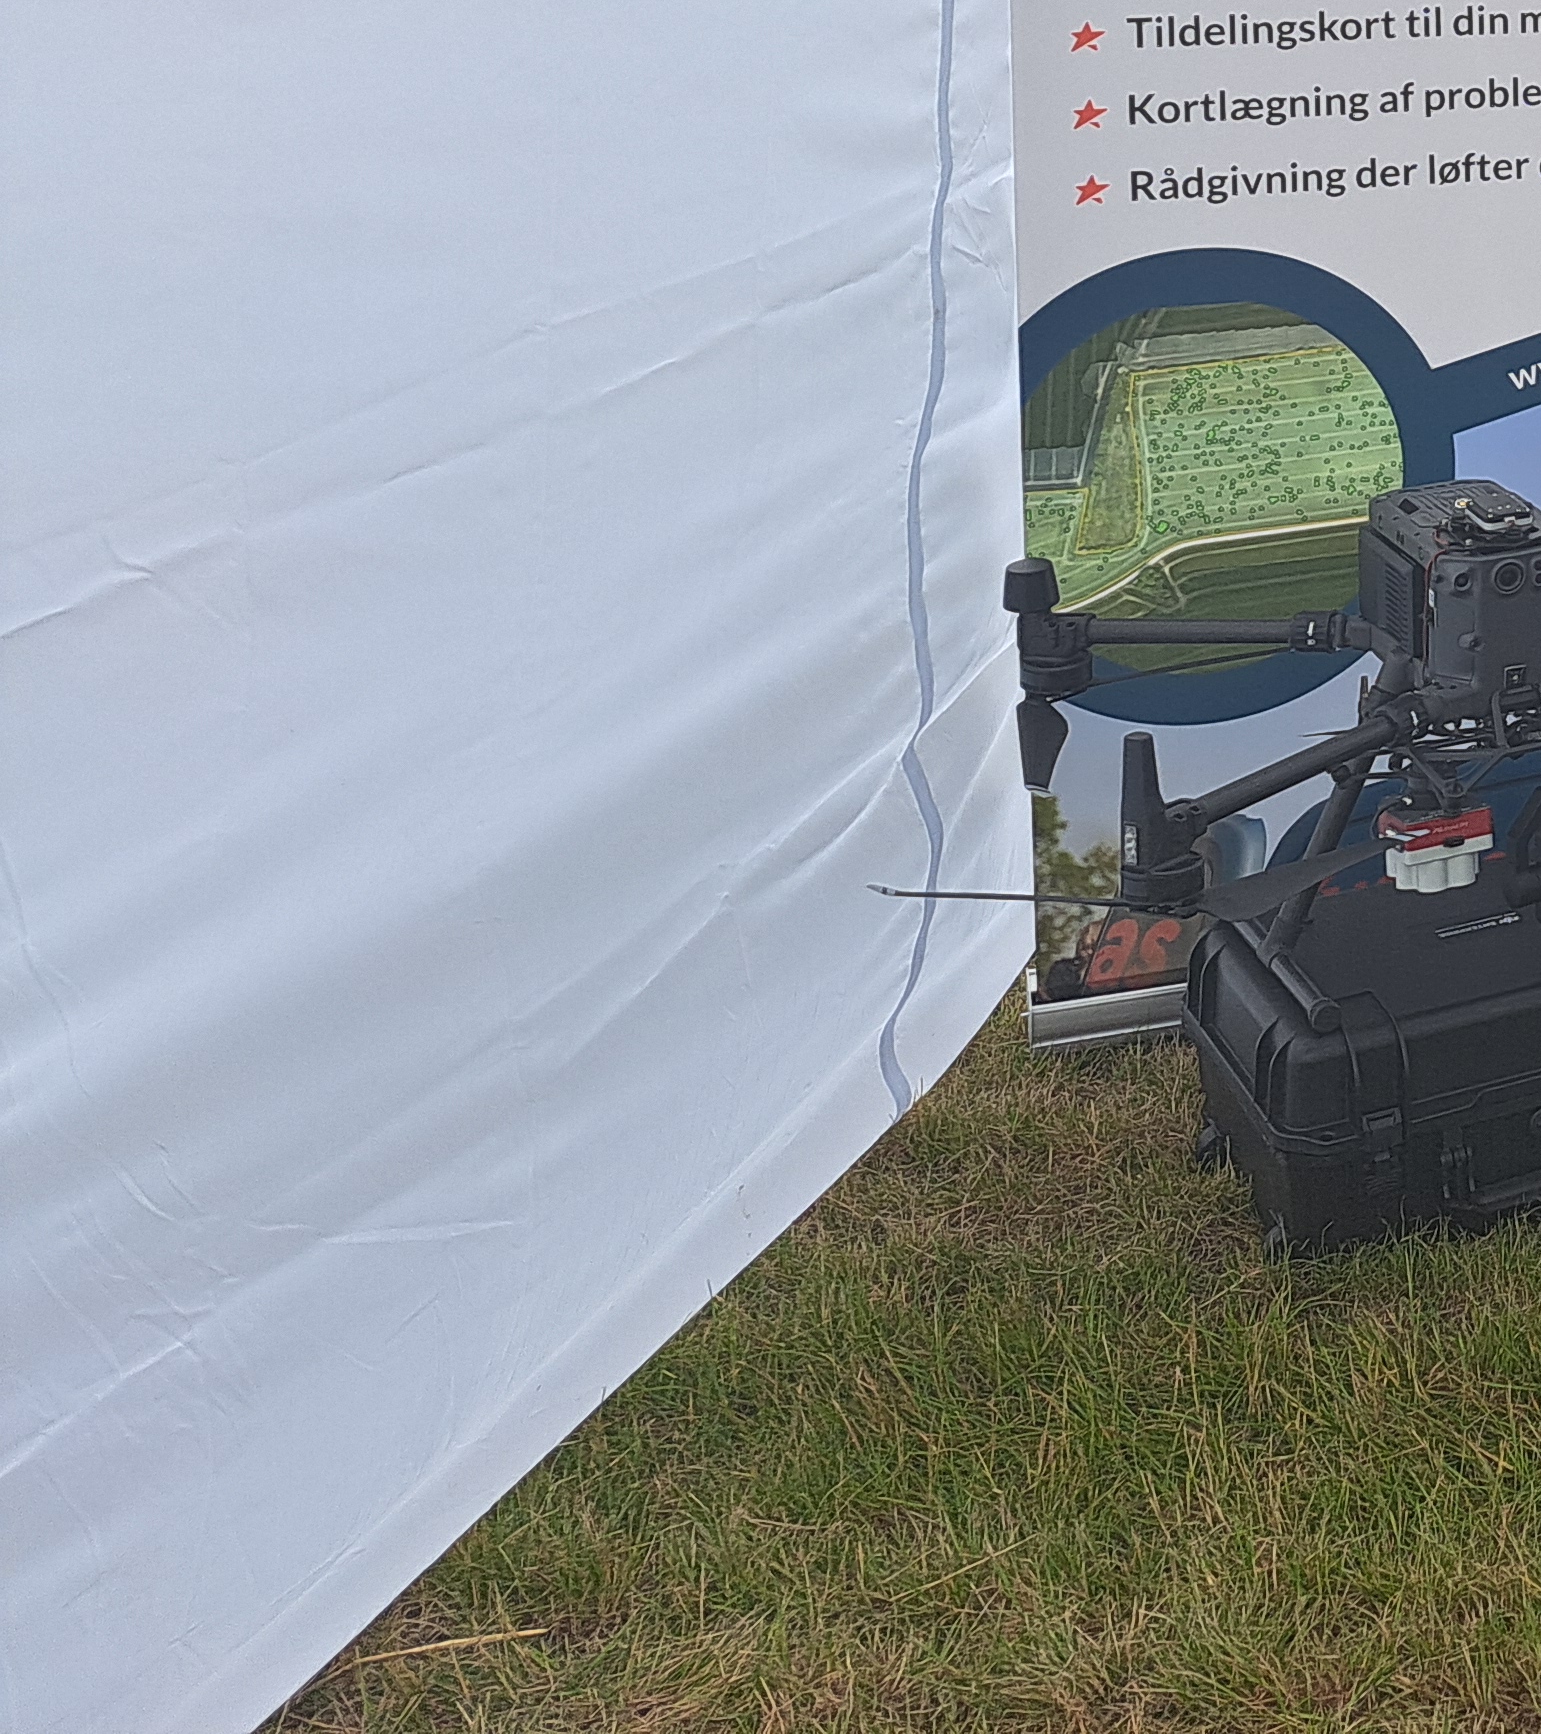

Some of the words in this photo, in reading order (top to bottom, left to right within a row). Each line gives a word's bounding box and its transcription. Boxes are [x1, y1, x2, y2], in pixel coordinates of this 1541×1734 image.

[1126, 10, 1396, 51] Tildelingskort
[1405, 5, 1442, 38] til
[1452, 5, 1509, 37] din
[1128, 86, 1369, 126] Kortlægning
[1379, 81, 1415, 114] af
[1130, 162, 1347, 205] Rådgivning
[1355, 157, 1418, 189] der
[1428, 152, 1530, 186] løfter
